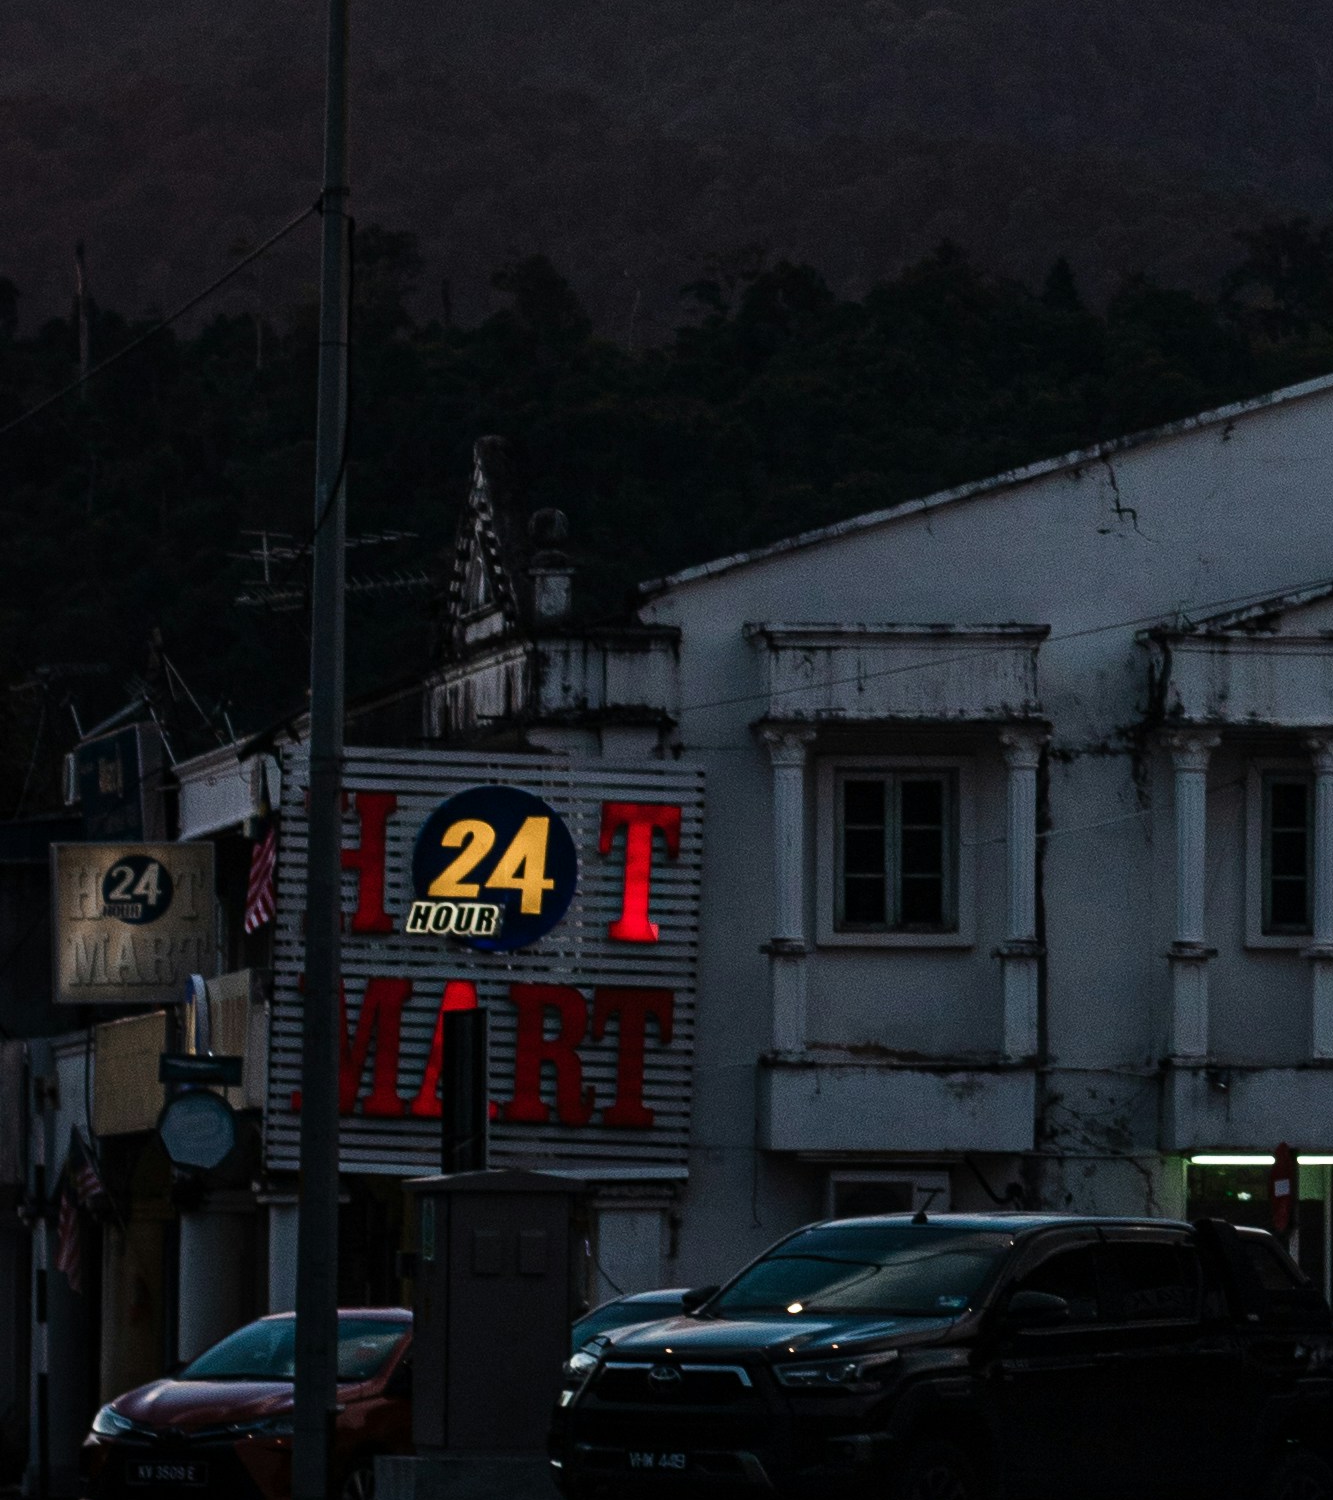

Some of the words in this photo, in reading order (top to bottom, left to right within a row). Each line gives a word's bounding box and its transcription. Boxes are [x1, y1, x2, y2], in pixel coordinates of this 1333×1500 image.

[111, 862, 162, 907] 24
[427, 815, 555, 916] 24
[407, 902, 499, 935] HOUR
